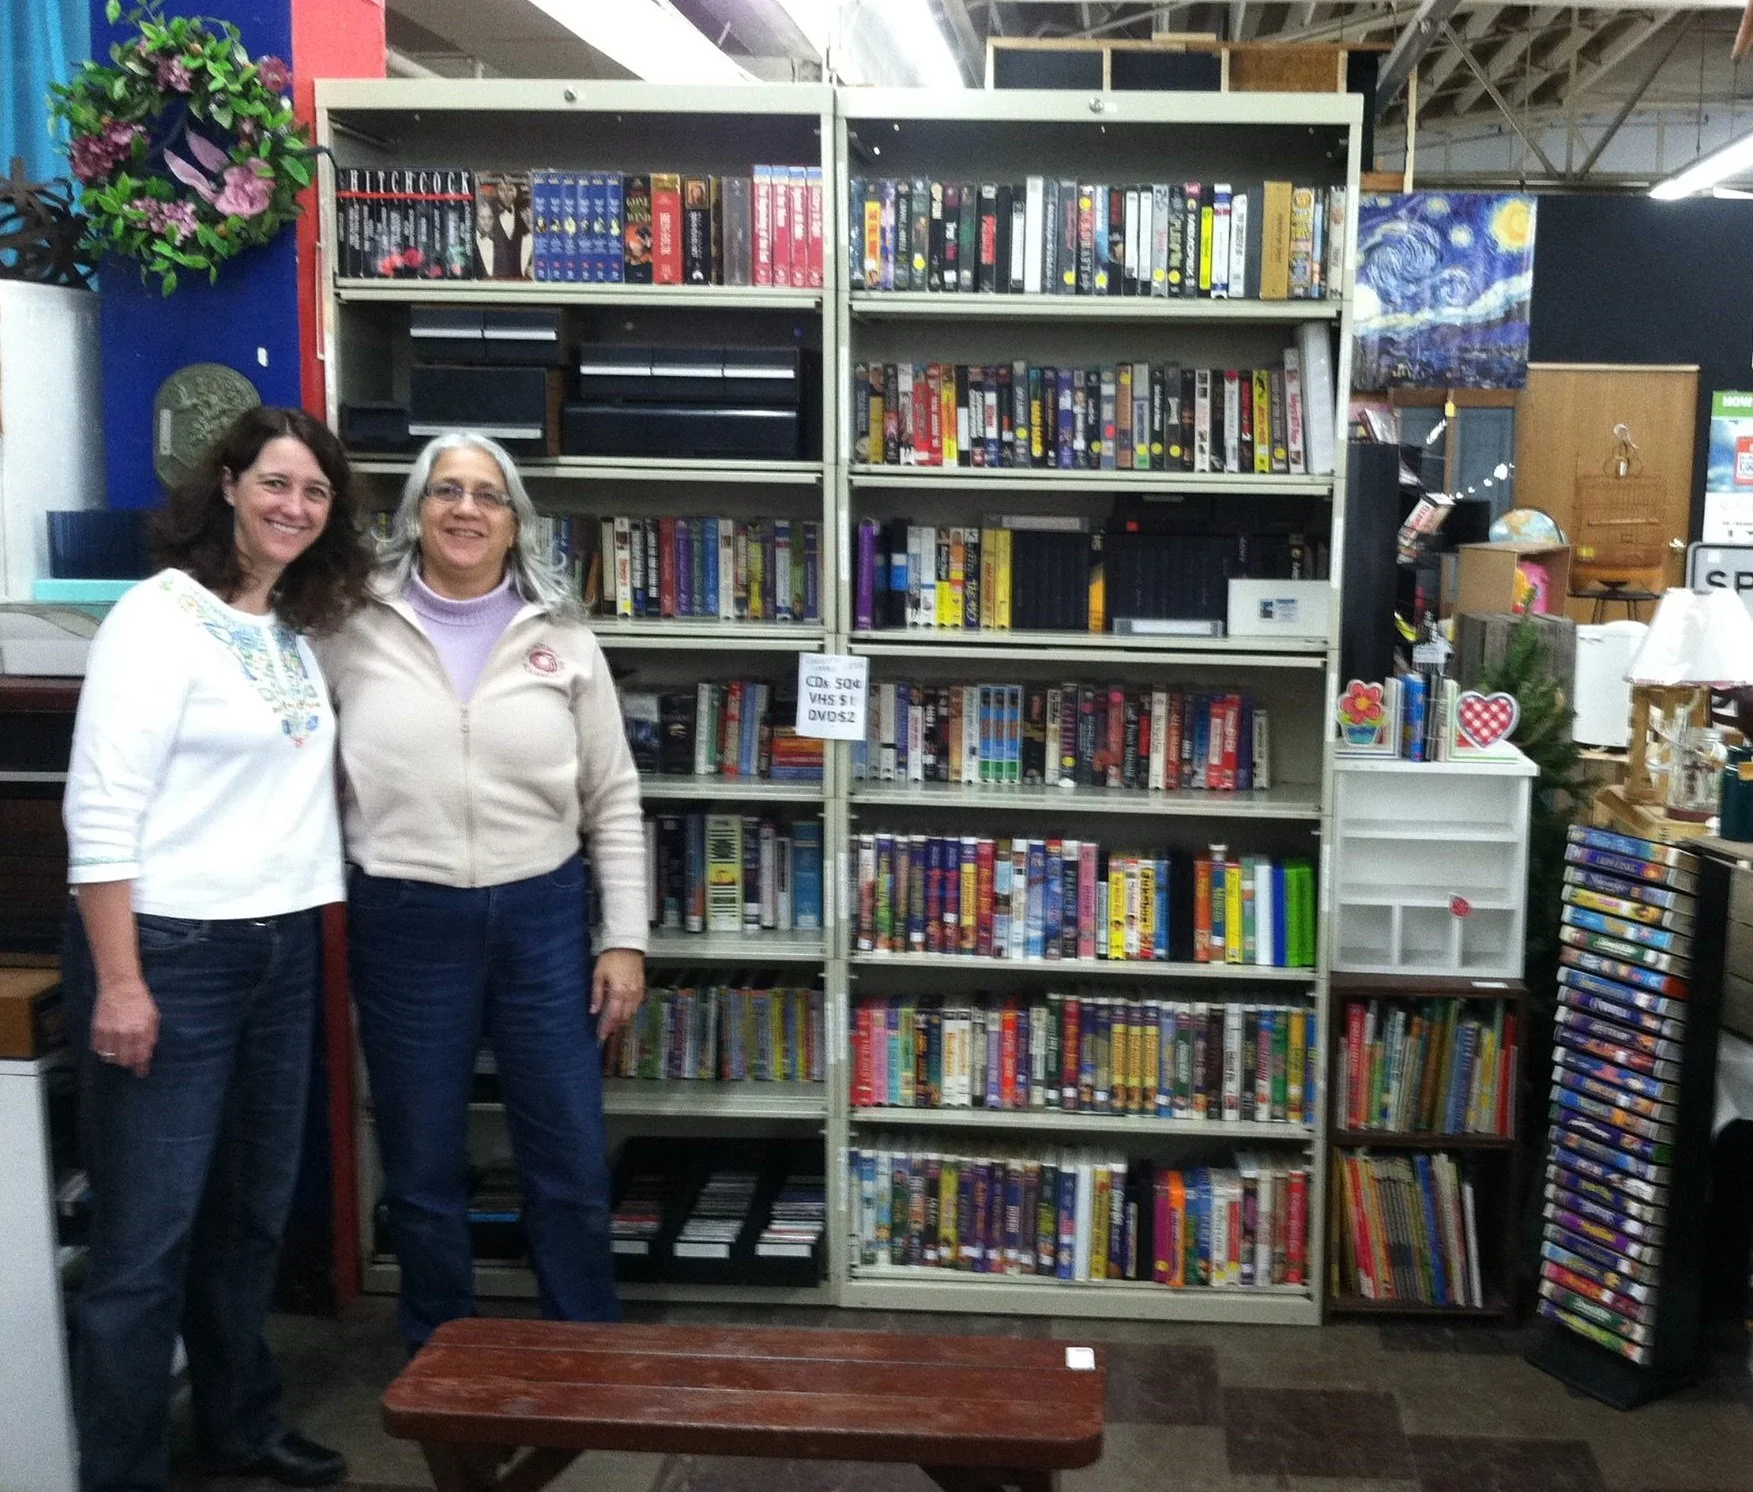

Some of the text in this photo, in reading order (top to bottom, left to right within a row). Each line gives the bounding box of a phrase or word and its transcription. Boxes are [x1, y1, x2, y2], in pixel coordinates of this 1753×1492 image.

[349, 169, 469, 195] HITCHCOCK
[805, 675, 828, 689] CDs
[808, 692, 835, 706] VHS
